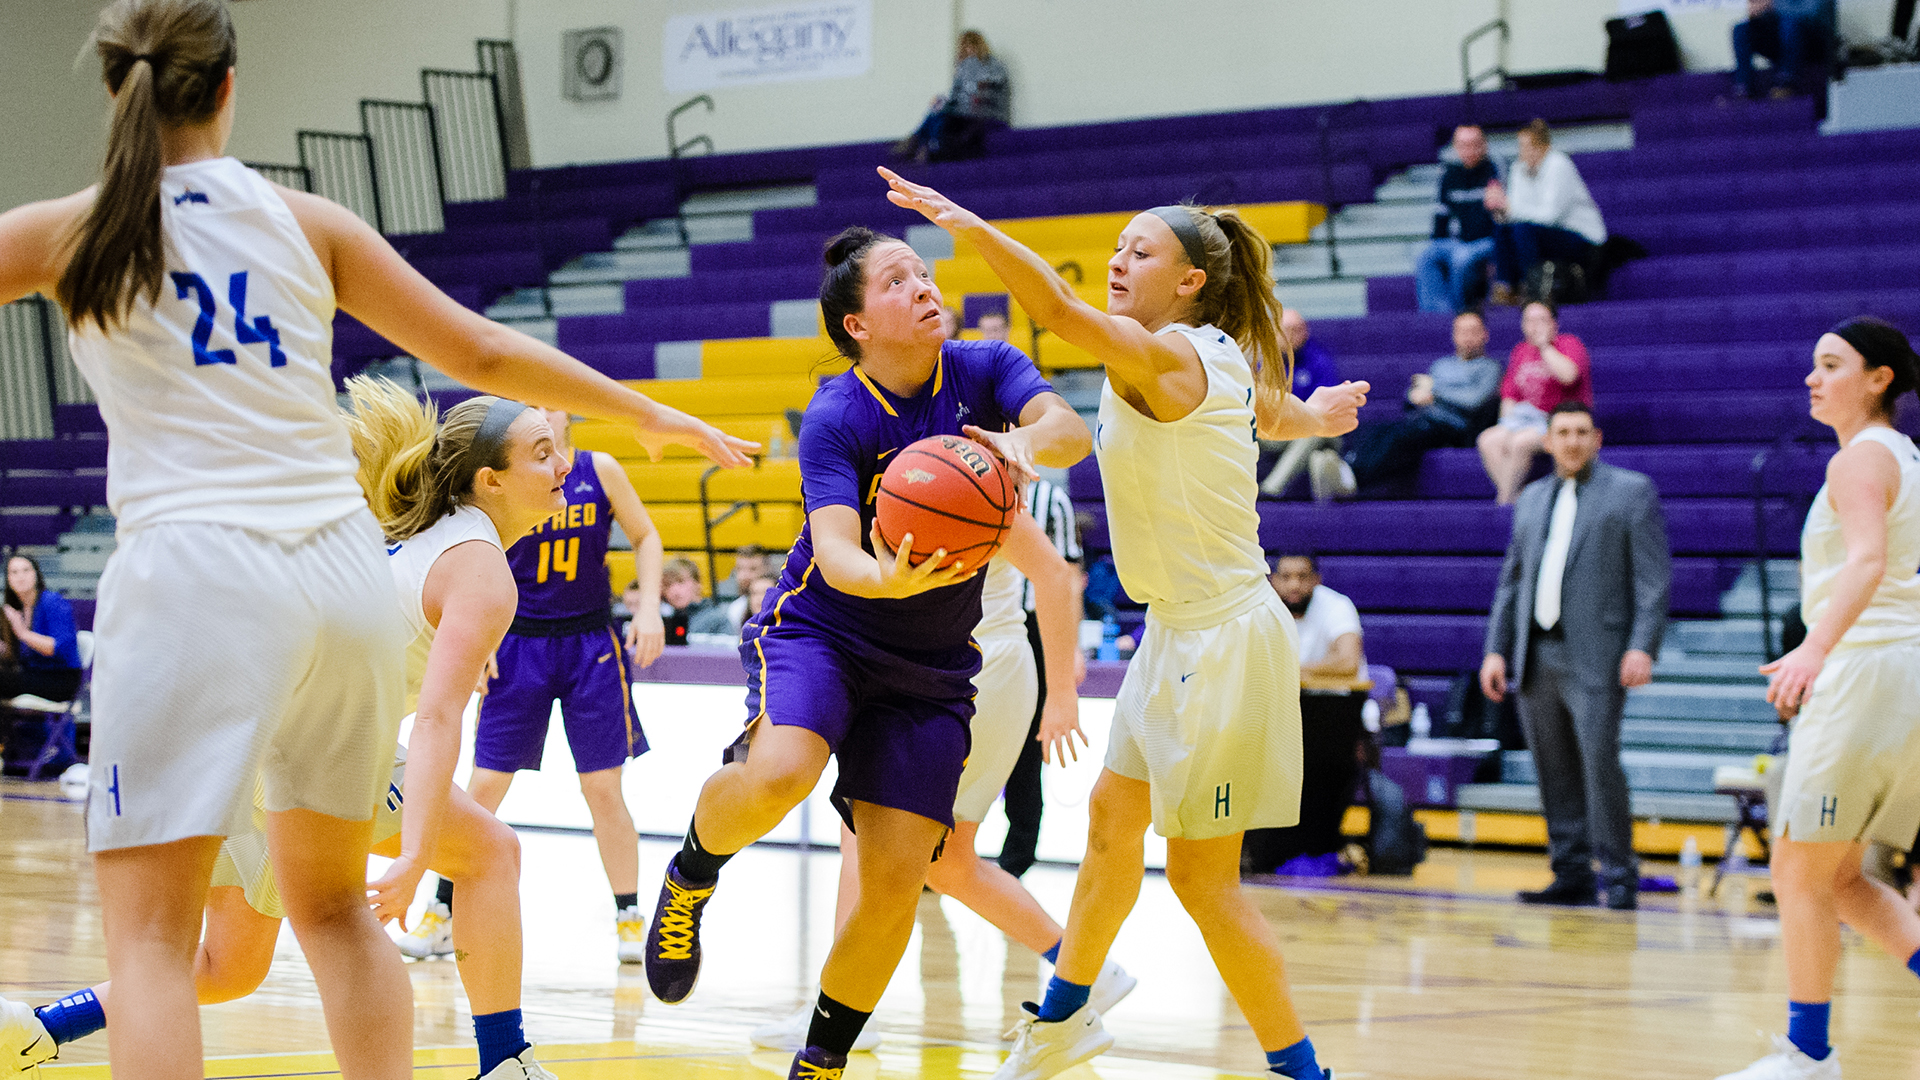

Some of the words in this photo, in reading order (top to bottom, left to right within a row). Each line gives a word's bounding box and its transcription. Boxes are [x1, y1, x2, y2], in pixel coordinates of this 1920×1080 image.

[679, 17, 856, 64] Allegany
[170, 270, 288, 368] 24
[536, 536, 580, 584] 14
[1214, 782, 1231, 819] H
[1820, 795, 1838, 827] H
